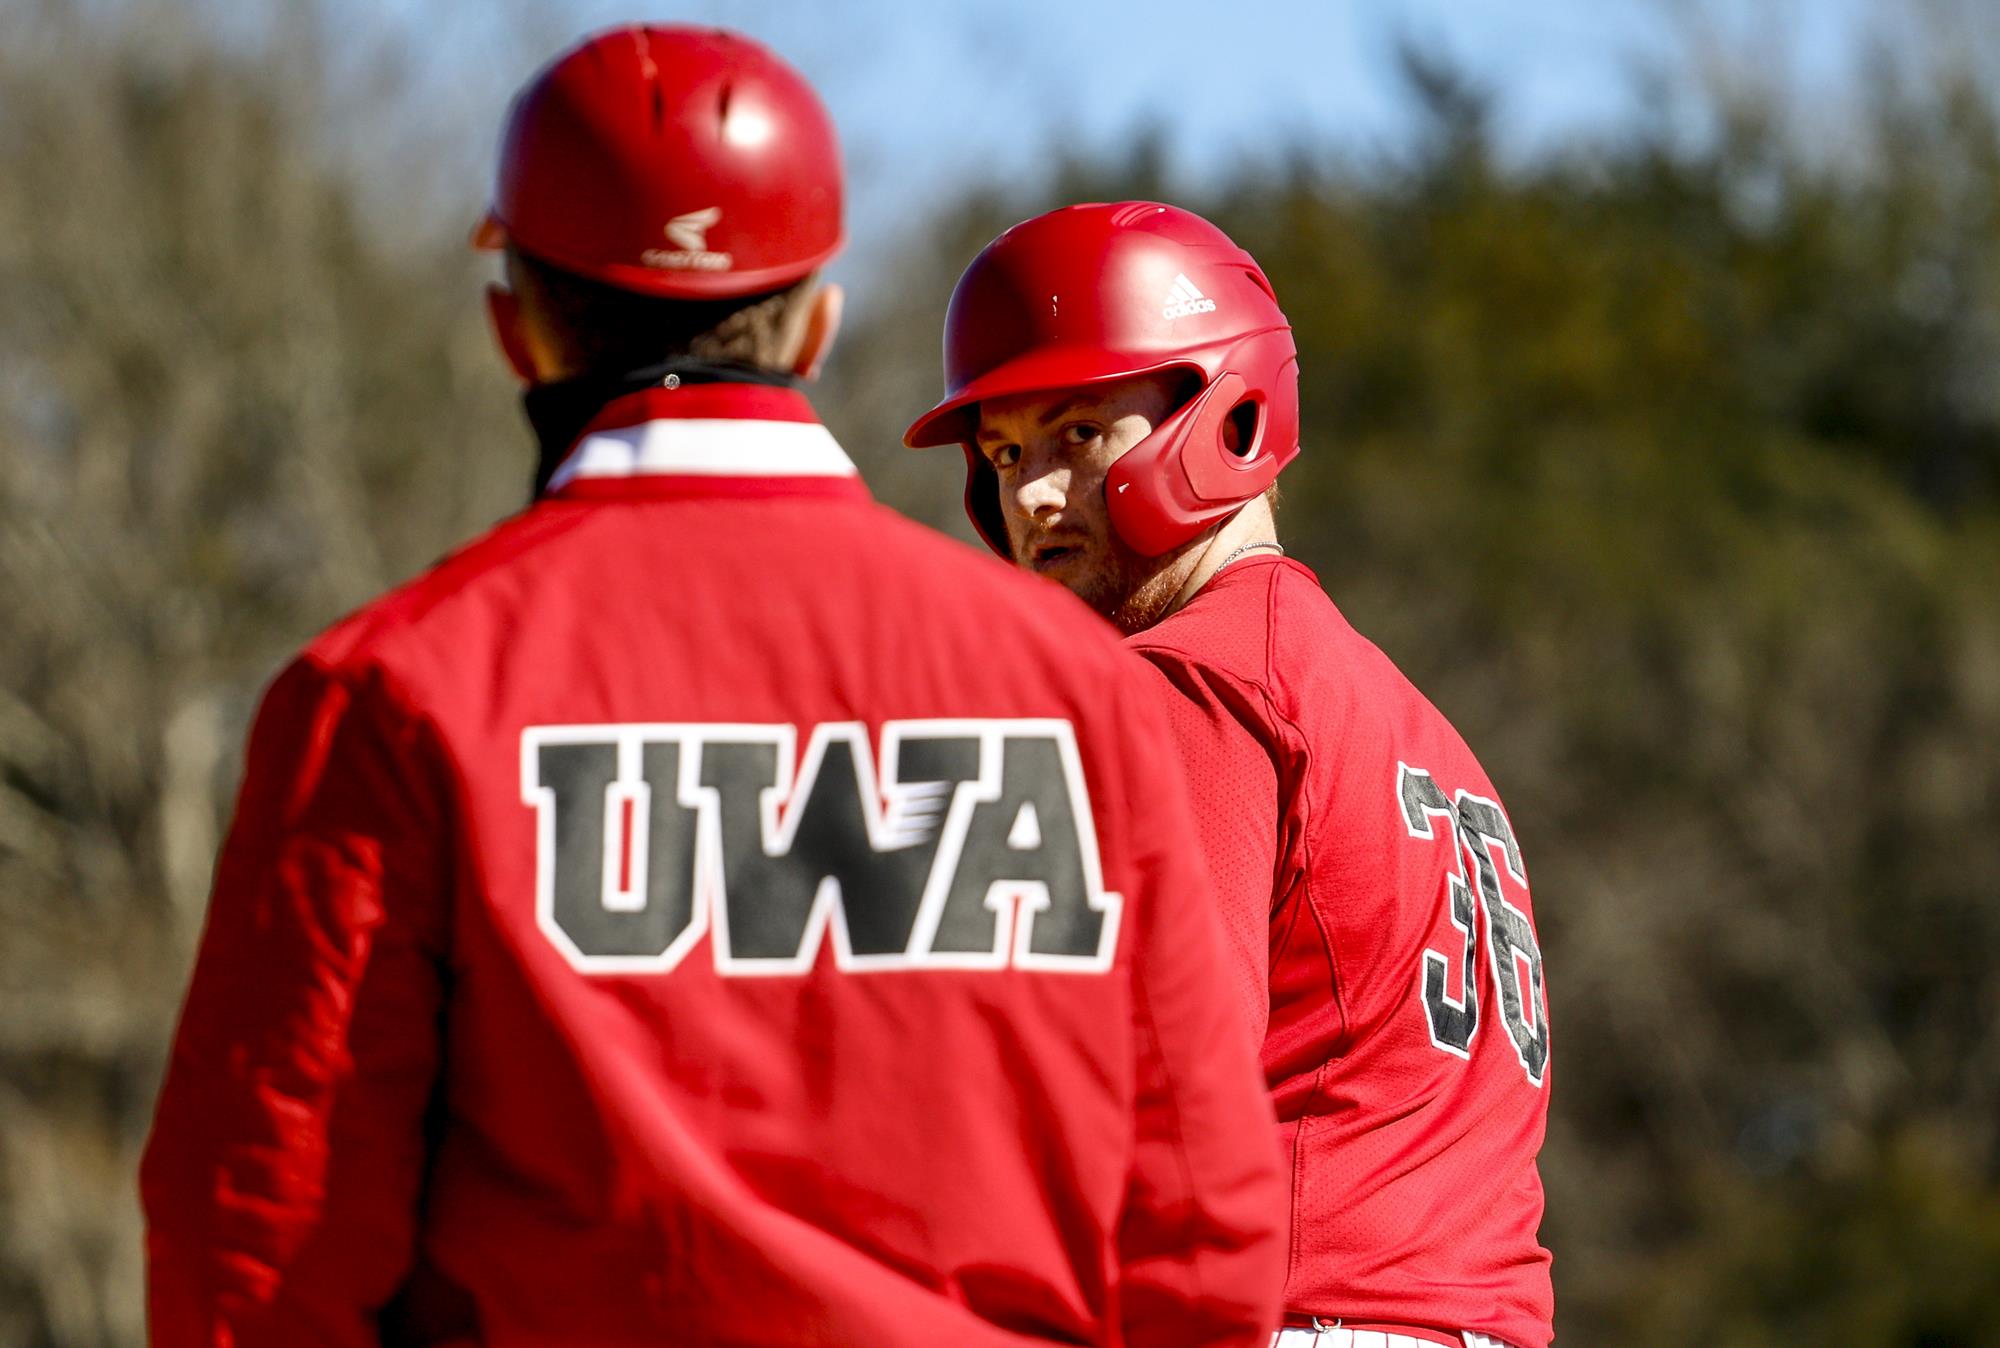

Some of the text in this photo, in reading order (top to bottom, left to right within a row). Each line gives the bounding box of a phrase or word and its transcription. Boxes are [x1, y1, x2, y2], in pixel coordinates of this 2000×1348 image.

[1162, 298, 1216, 320] adidas
[521, 719, 1123, 974] UWA
[1397, 760, 1549, 1088] 36
